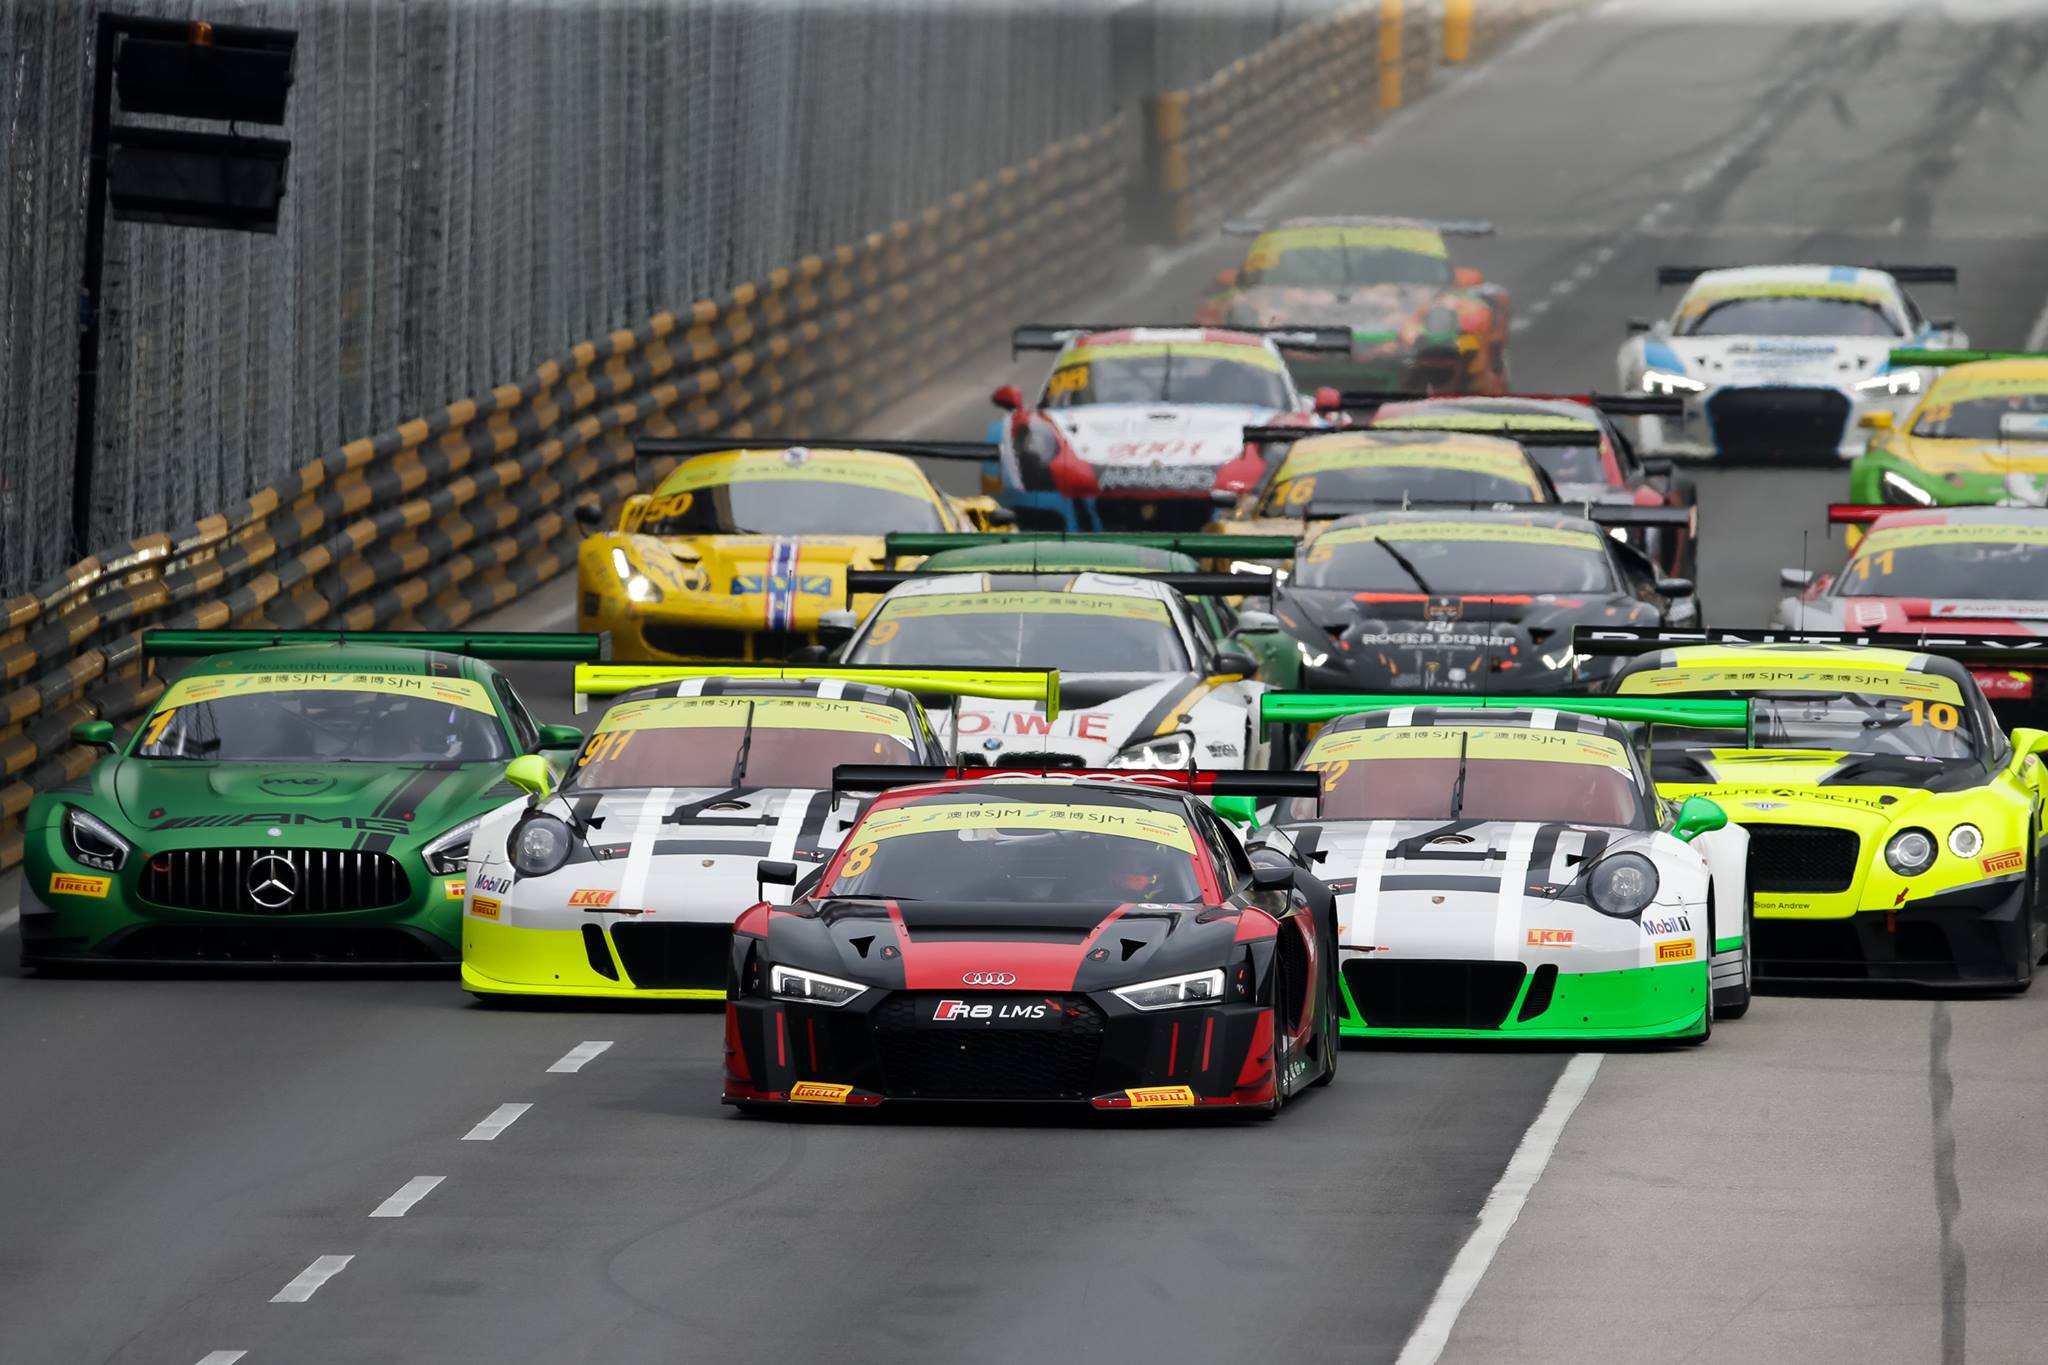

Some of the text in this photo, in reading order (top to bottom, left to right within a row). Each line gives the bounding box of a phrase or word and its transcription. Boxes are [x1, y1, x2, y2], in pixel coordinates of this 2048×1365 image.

[1274, 477, 1317, 505] 16
[1853, 550, 1895, 580] 11
[867, 620, 898, 647] 9
[1362, 633, 1433, 645] ROGER
[292, 673, 327, 684] SJM
[387, 676, 421, 689] SJM
[1759, 672, 1793, 681] SJM
[1855, 675, 1889, 685] SJM
[719, 699, 751, 707] SJM
[815, 702, 849, 712] SJM
[1900, 699, 1959, 731] 10
[144, 708, 177, 746] 1
[1432, 731, 1463, 739] SJM
[1531, 734, 1566, 745] SJM
[578, 730, 636, 766] 911
[984, 809, 1021, 819] SJM
[1087, 813, 1125, 824] SJM
[232, 813, 410, 835] AMG
[841, 843, 878, 877] 8
[1983, 851, 2023, 872] PIRELLI
[54, 876, 103, 893] PIRELLI
[474, 873, 501, 892] Mobil
[499, 879, 512, 895] 1
[569, 890, 614, 904] LKM
[472, 899, 497, 916] PIRELLI
[1642, 916, 1691, 936] Mobil 1
[1527, 930, 1574, 944] LKM
[1659, 943, 1693, 958] PIRELLI
[946, 1004, 1046, 1018] R8 LMS
[795, 1084, 846, 1098] PIRELLI
[1132, 1089, 1188, 1102] PIRELLI
